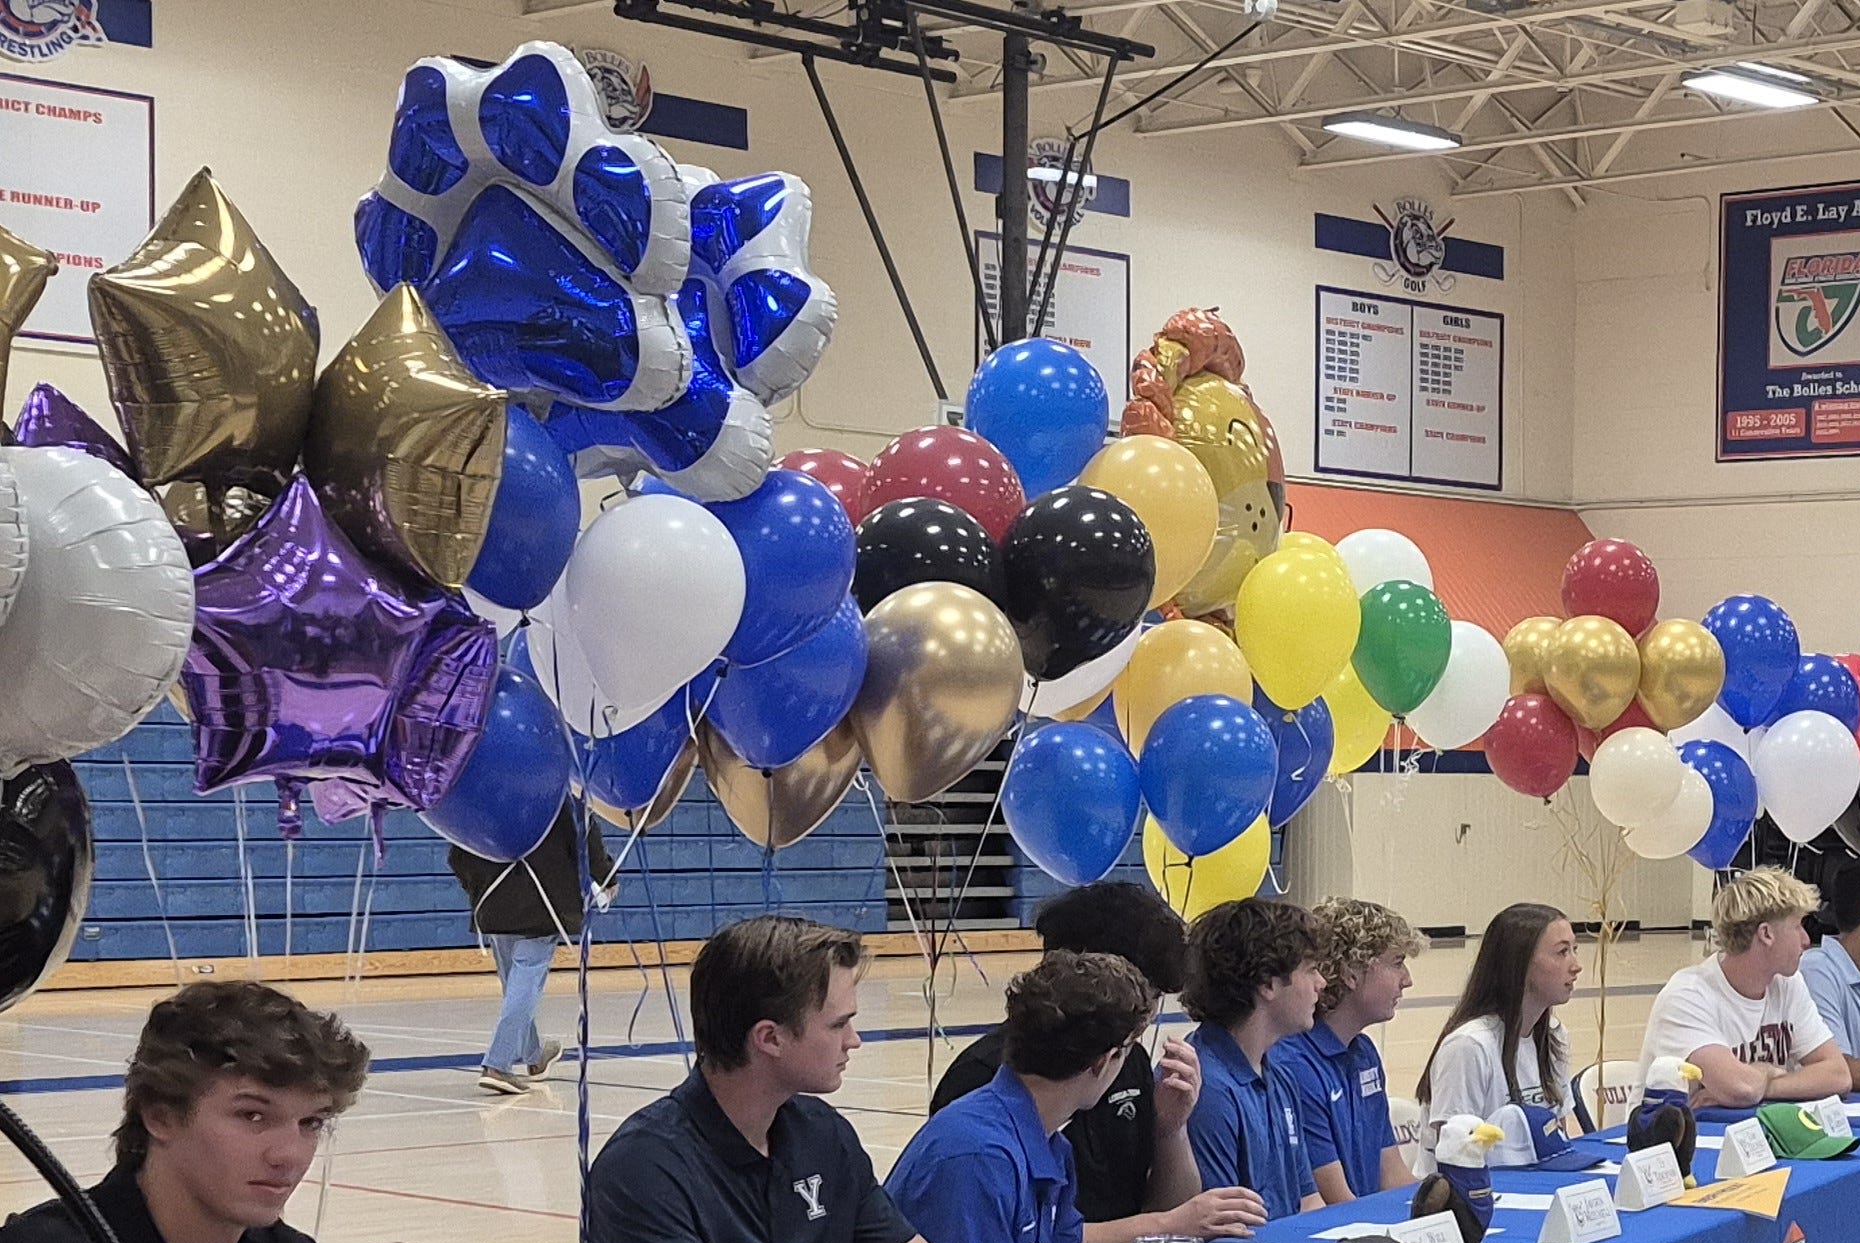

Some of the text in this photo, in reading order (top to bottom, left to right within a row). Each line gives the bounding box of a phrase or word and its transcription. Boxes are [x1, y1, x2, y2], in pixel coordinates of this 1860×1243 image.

[0, 31, 73, 59] RESTLING
[35, 103, 103, 125] CHAMPS
[10, 190, 101, 214] RUNNER-UP
[1397, 201, 1435, 221] BOLLES
[1745, 205, 1792, 228] Floyd
[1795, 205, 1812, 222] E.
[1817, 202, 1848, 222] Lay
[1404, 279, 1427, 293] GOLF
[1351, 301, 1380, 315] BOYS
[1443, 315, 1471, 329] GIRLS
[1766, 385, 1790, 399] The
[1793, 382, 1833, 397] Bolles
[1770, 413, 1796, 426] 2005
[793, 1174, 828, 1220] Y
